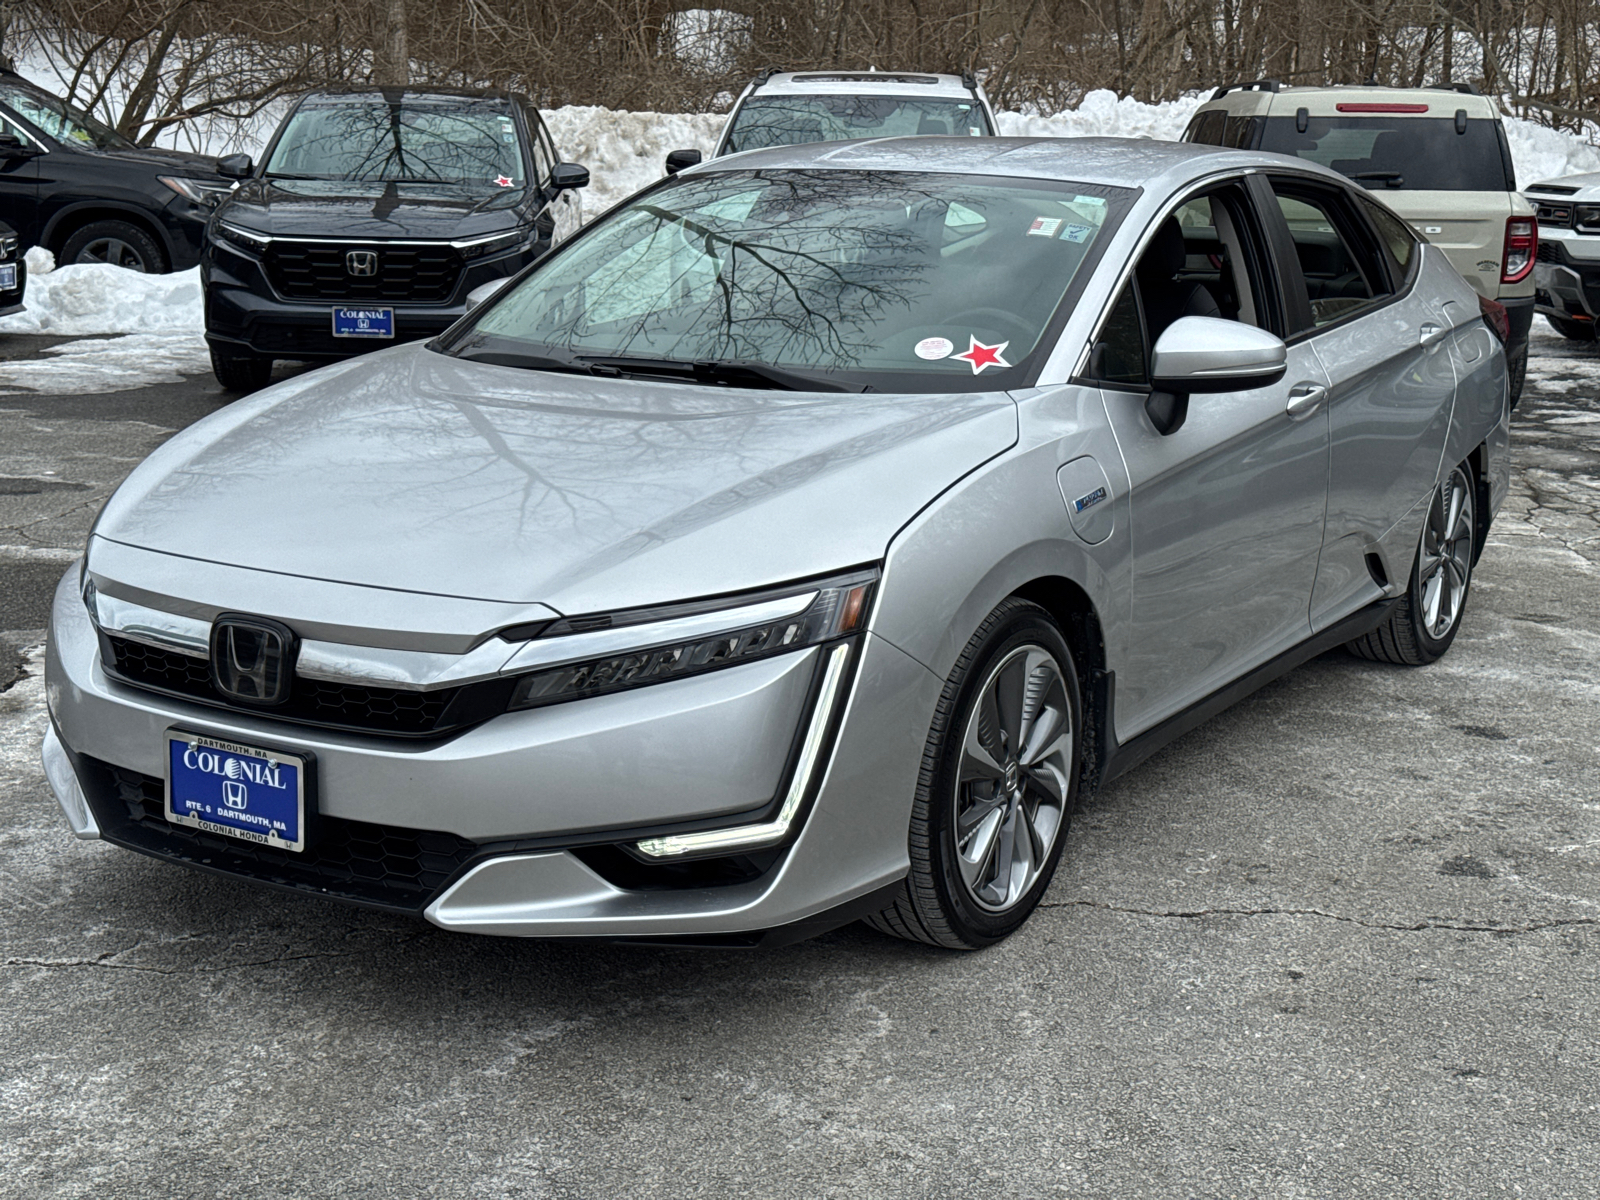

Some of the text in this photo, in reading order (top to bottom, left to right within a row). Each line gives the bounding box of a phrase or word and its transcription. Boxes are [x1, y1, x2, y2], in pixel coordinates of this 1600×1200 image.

[340, 311, 387, 319] COLONIAL
[254, 750, 268, 759] MA
[183, 749, 286, 789] COLONIAL
[185, 800, 287, 831] RTE. 6 DARTMOUTH, MA
[197, 821, 269, 844] COLONIAL HONDA
